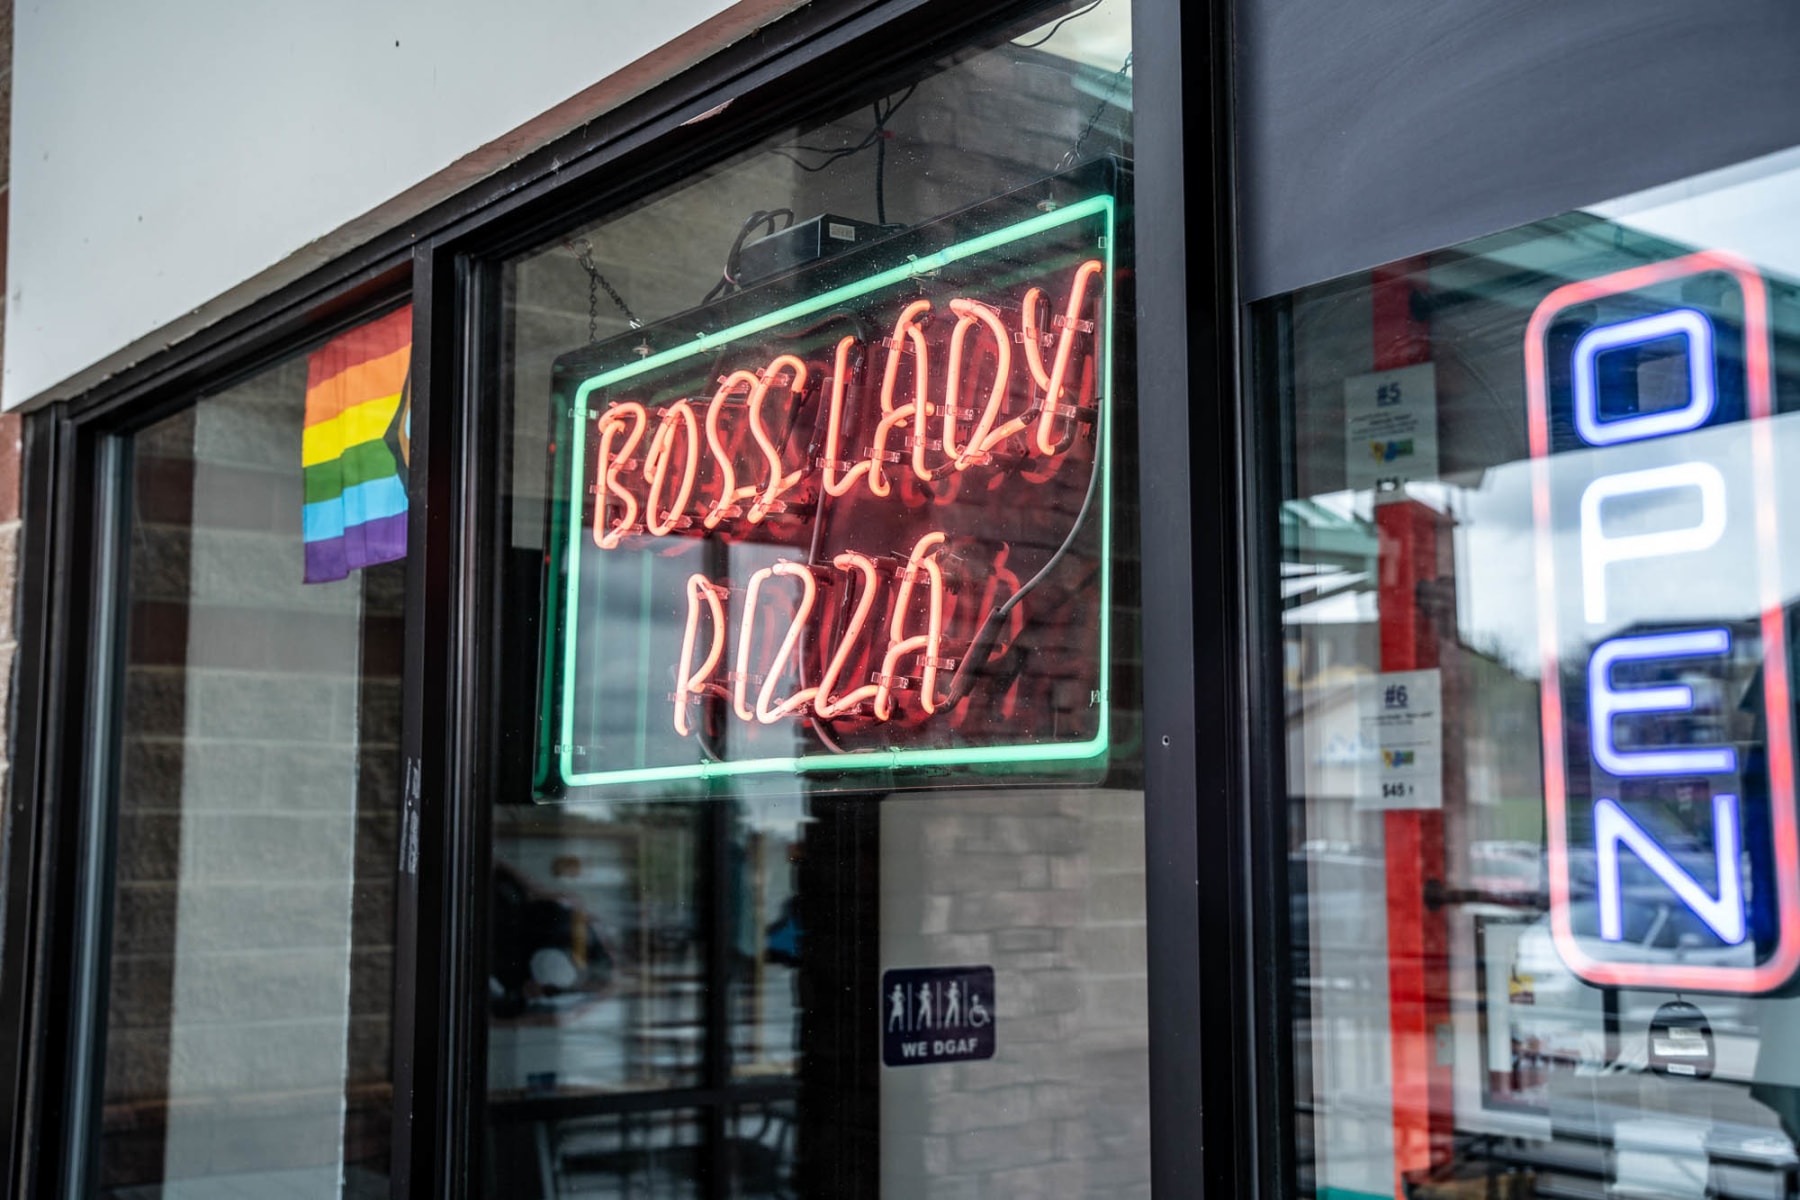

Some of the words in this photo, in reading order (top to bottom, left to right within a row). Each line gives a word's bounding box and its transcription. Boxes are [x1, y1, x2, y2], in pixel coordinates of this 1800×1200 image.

[593, 355, 807, 549] BOSS
[823, 260, 1103, 498] LADY
[1377, 383, 1401, 405] #5
[673, 531, 947, 736] PIZZA
[1571, 307, 1749, 946] OPEN
[1384, 685, 1408, 706] #6
[901, 1041, 928, 1058] WE
[933, 1038, 978, 1055] DGAF
